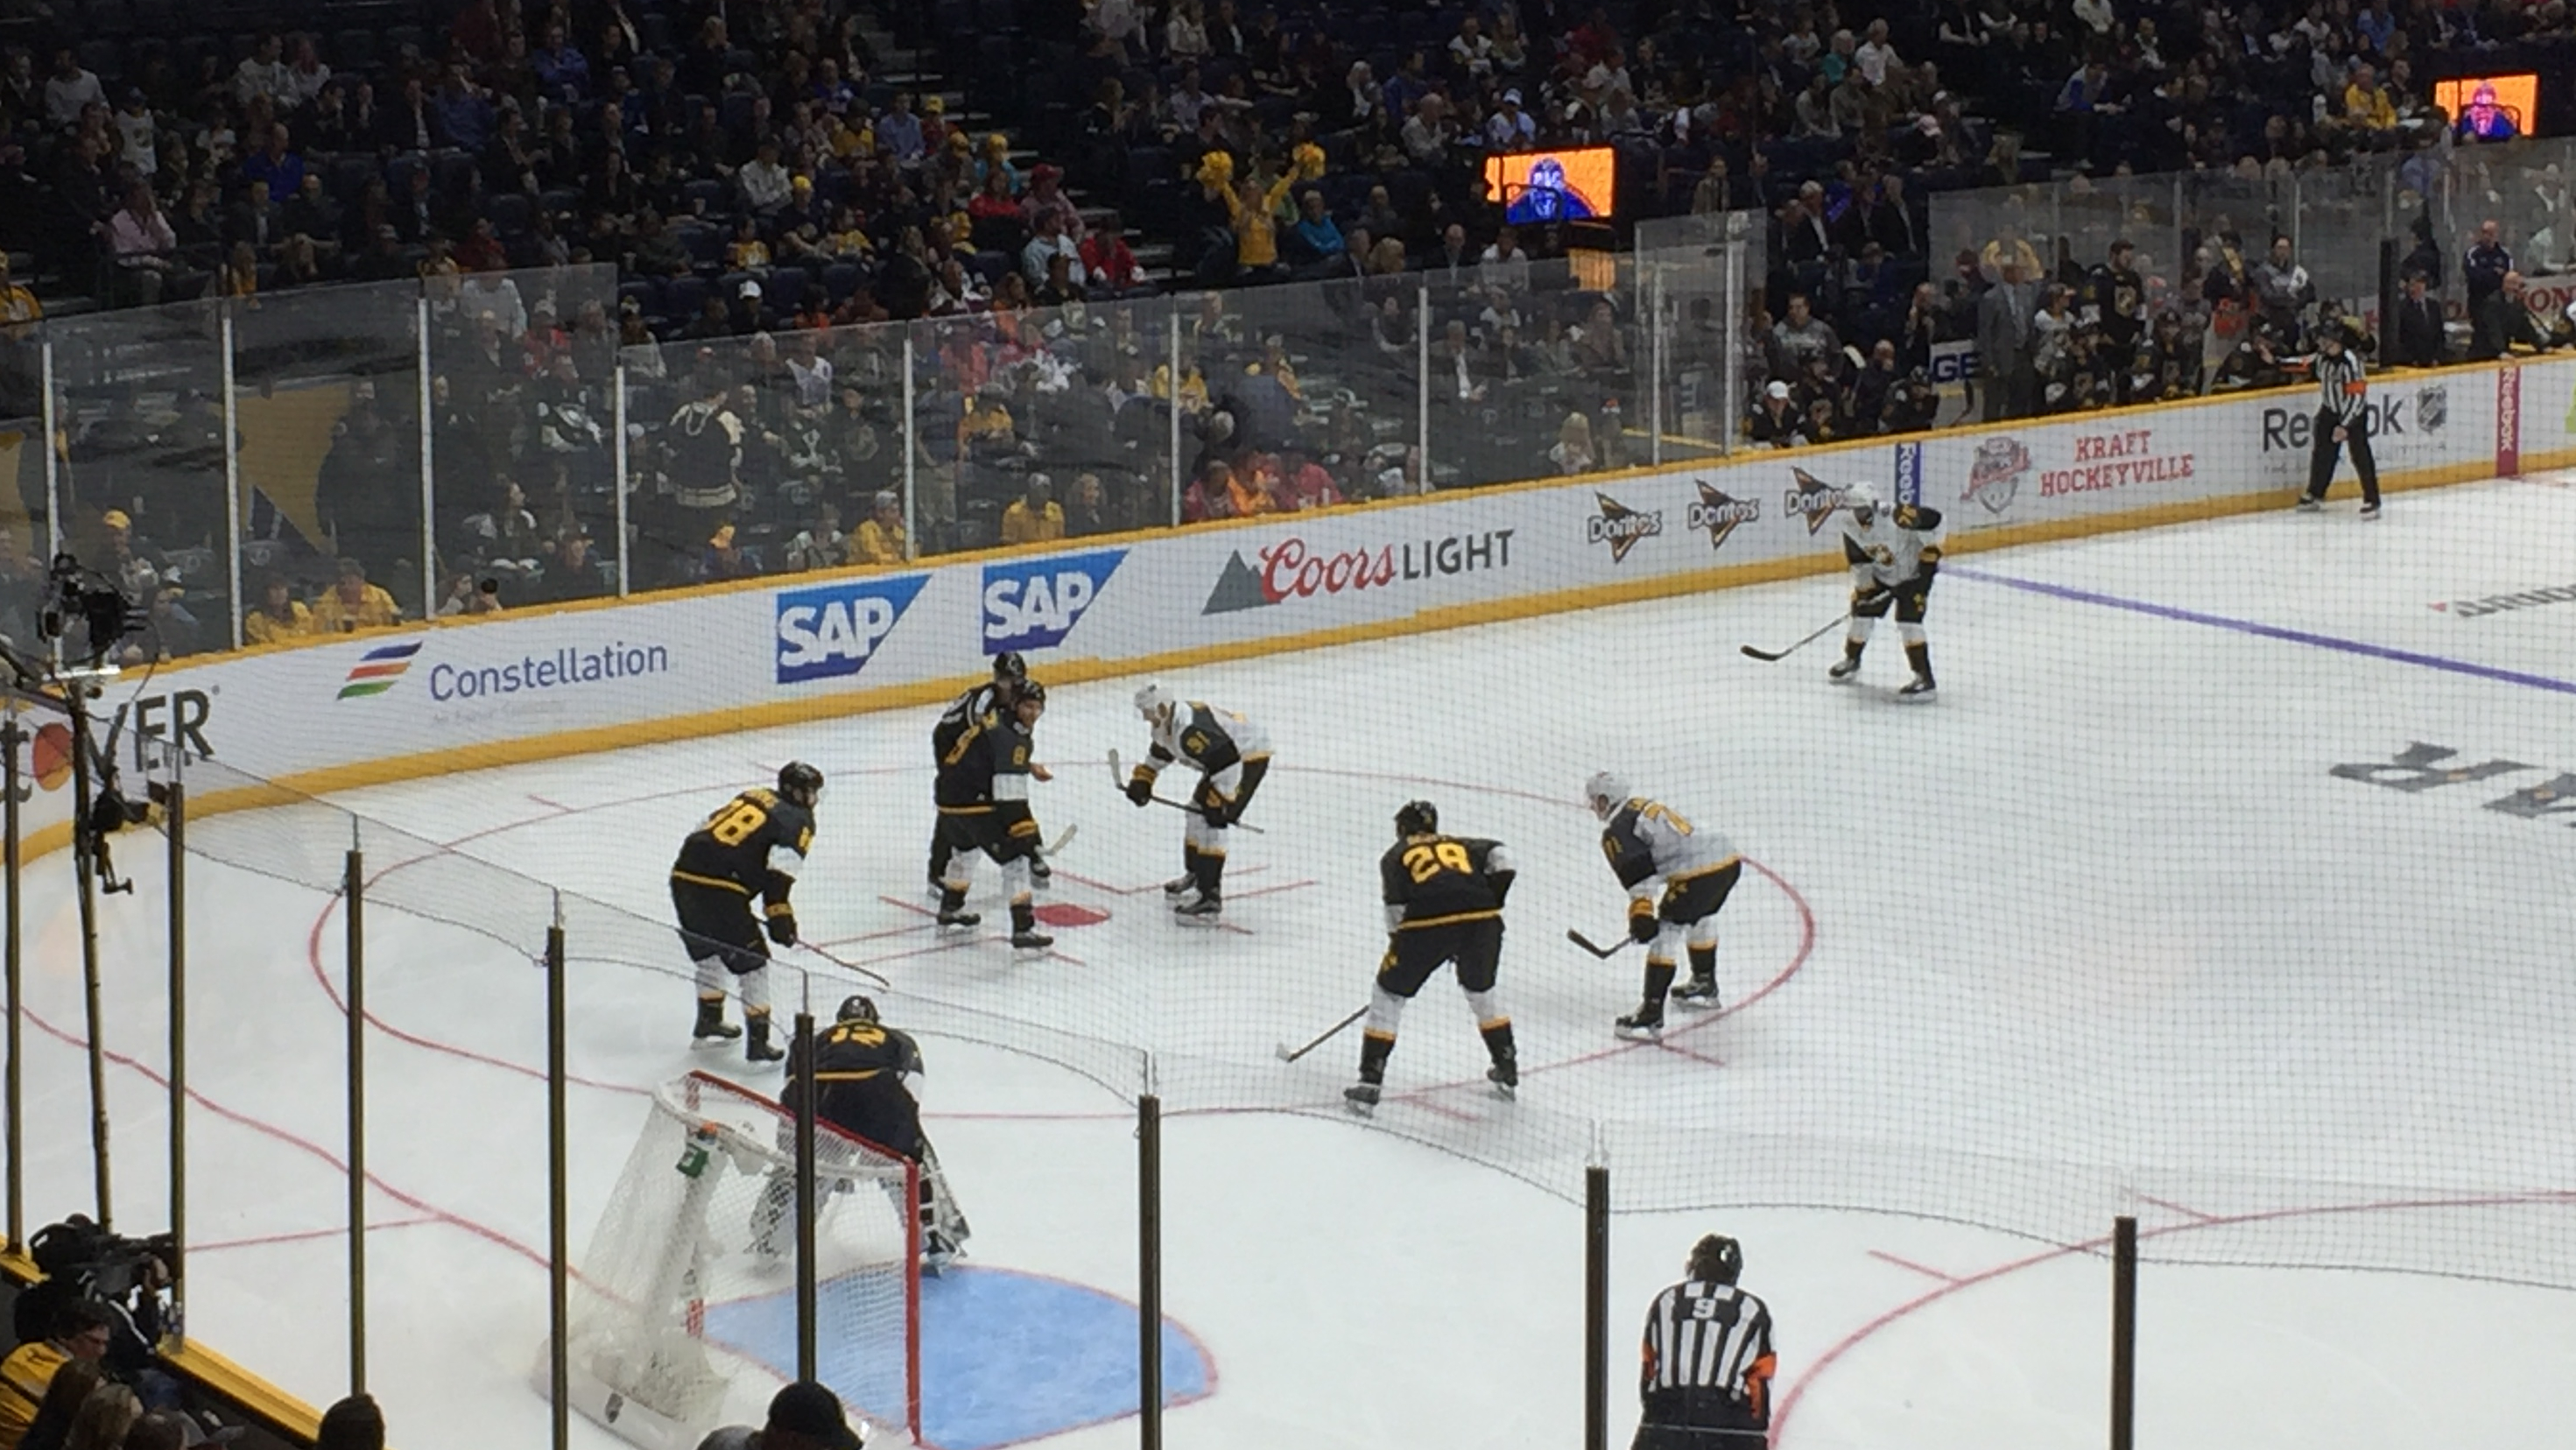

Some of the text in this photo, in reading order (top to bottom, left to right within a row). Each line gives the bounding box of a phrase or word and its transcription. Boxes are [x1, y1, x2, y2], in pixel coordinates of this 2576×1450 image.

[2075, 430, 2151, 462] KRAFT
[2263, 394, 2404, 453] Reok
[2039, 454, 2194, 497] HOCKEYVILLE
[1588, 510, 1662, 543] Doritos
[1688, 498, 1760, 530] Doritos
[1259, 529, 1514, 604] Coors LIGHT
[984, 571, 1093, 640] SAP
[779, 596, 894, 667] SAP
[430, 641, 667, 700] Constellation
[1693, 1299, 1716, 1319] 9
